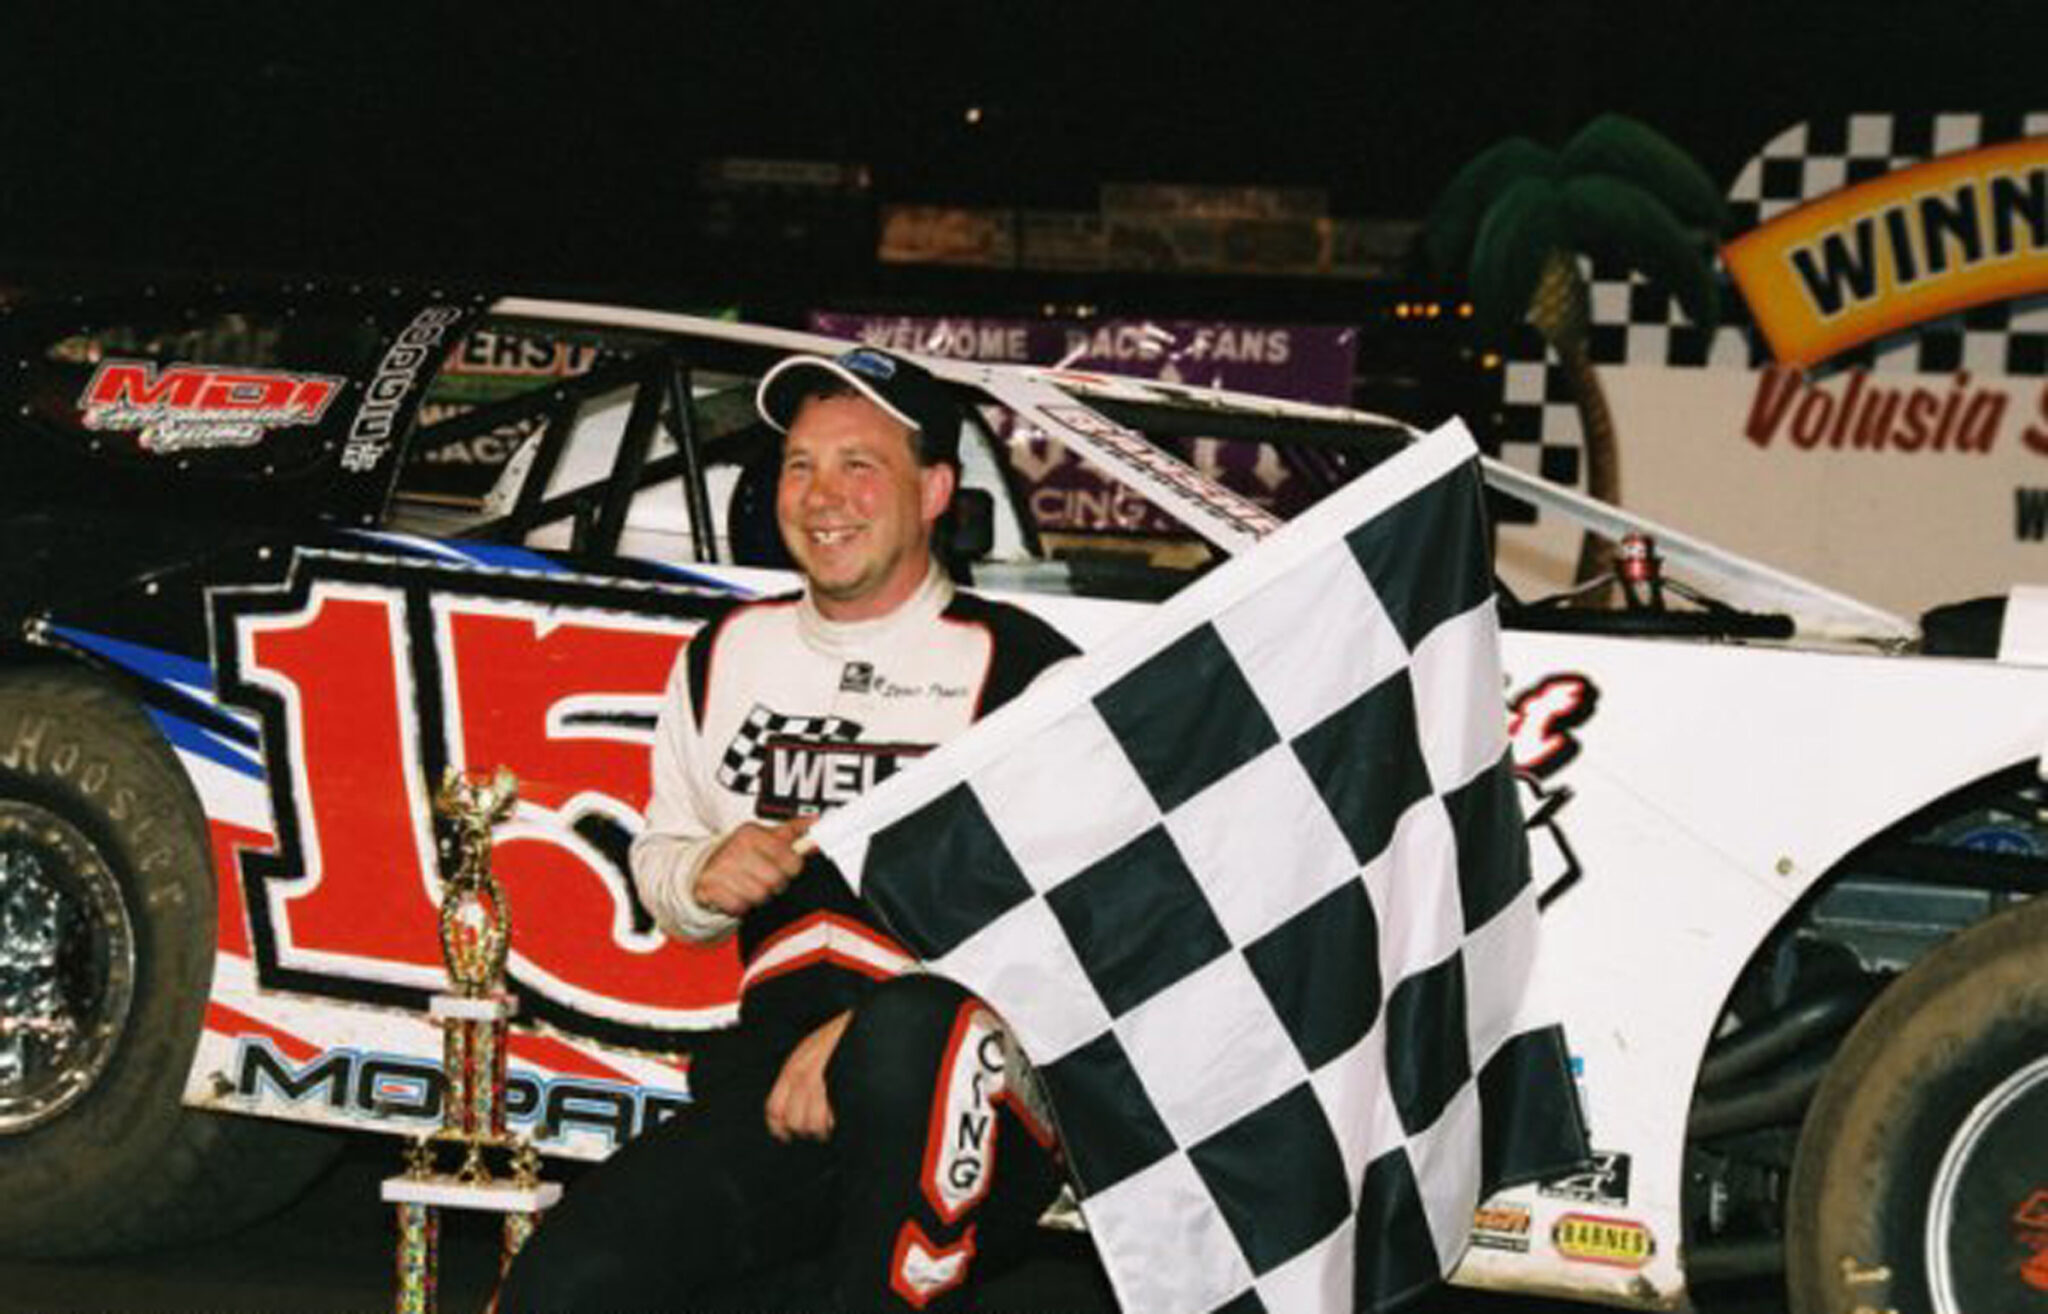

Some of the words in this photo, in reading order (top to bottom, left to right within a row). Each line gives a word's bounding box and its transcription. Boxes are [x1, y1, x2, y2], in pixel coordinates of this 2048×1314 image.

[858, 320, 1028, 361] WELCOME
[1192, 329, 1291, 364] FANS
[82, 359, 346, 424] MDI
[1745, 366, 2009, 456] Volusia
[238, 582, 746, 1026] 15
[773, 747, 903, 802] WEL
[237, 1035, 690, 1141] MOA
[949, 1030, 1005, 1190] CING
[1563, 1219, 1644, 1254] BARNES
